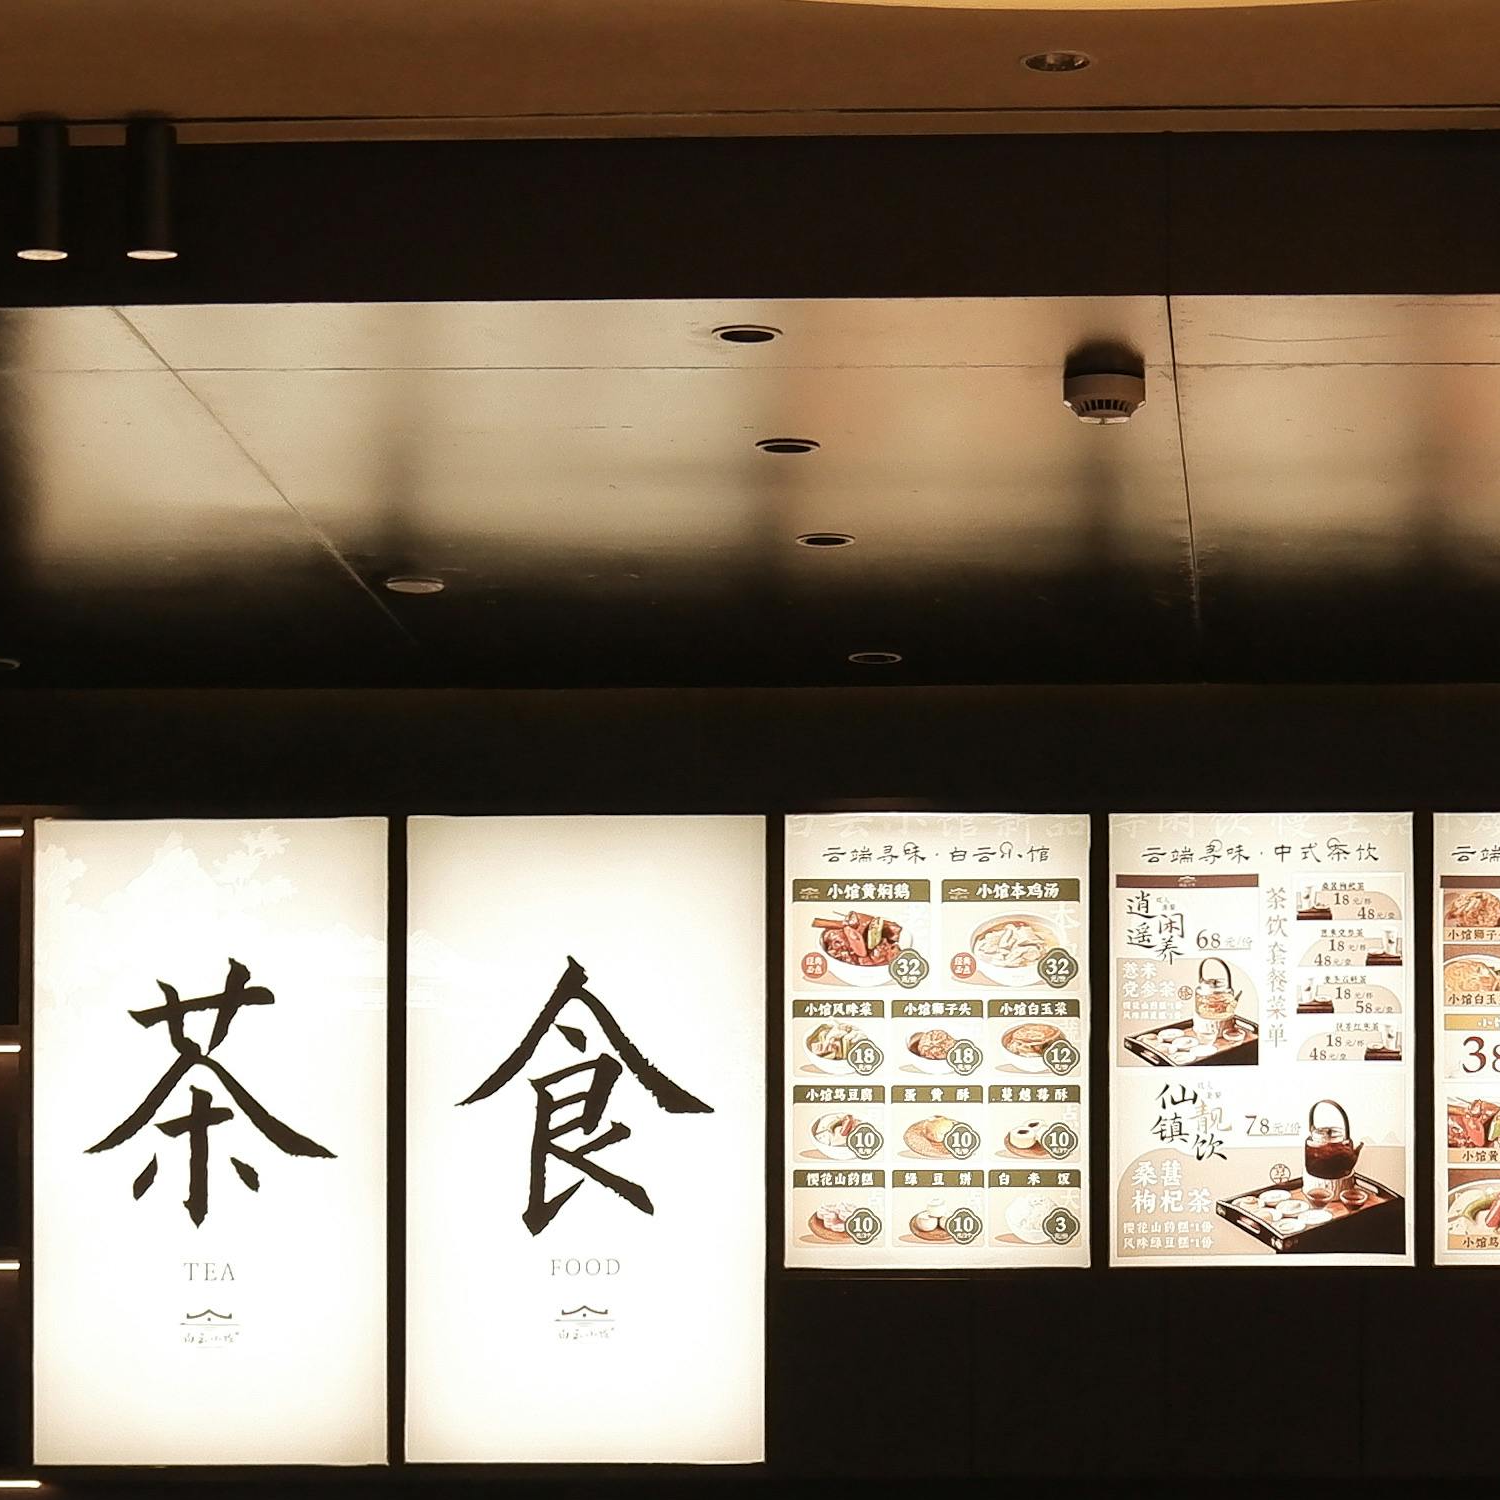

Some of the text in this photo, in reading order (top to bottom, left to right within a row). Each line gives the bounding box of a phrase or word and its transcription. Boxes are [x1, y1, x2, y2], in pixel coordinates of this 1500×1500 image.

[827, 882, 911, 900] 小馆黄焖鹅
[975, 882, 1060, 900] 小馆本鸡汤
[897, 958, 921, 976] 32
[1046, 958, 1070, 976] 32
[854, 1049, 874, 1064] 18
[953, 1049, 974, 1064] 18
[1050, 1048, 1071, 1063] 12
[83, 957, 339, 1229] 茶
[454, 955, 716, 1238] 食
[855, 1132, 876, 1148] 10
[952, 1132, 972, 1148] 10
[1050, 1132, 1070, 1148] 10
[998, 1171, 1071, 1186] 白米饭
[1132, 1159, 1183, 1187] 桑葚
[1132, 1187, 1213, 1215] 枸杞茶
[853, 1217, 873, 1233] 10
[953, 1217, 974, 1233] 10
[1055, 1217, 1066, 1232] 3
[183, 1262, 235, 1281] TEA
[551, 1258, 621, 1276] FOOD
